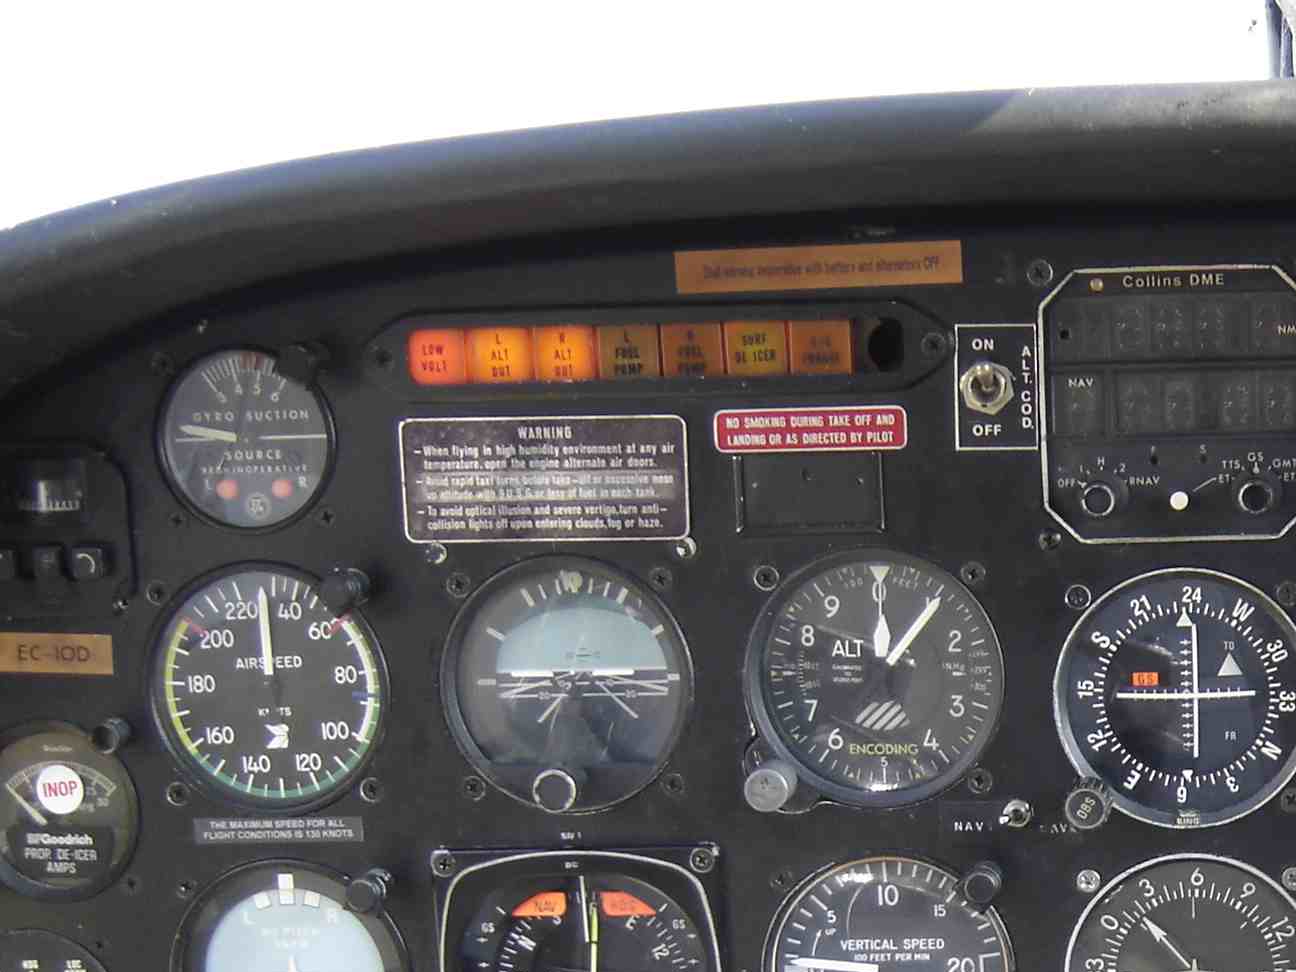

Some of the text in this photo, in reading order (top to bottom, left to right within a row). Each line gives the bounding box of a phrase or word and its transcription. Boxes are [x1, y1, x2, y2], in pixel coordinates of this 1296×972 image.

[1122, 273, 1224, 288] Collins DME
[423, 345, 443, 355] LOW
[972, 338, 994, 350] ON
[422, 360, 447, 371] VOLT
[1068, 378, 1093, 388] NAV
[726, 414, 894, 428] NO SMOKING DURING TAKE OFF AND
[518, 426, 572, 440] WARNING
[972, 424, 1002, 436] OFF
[728, 432, 894, 446] LANDING OR AS DIRECTED BY PILOT
[225, 450, 281, 460] SOURCE
[226, 602, 257, 619] 220
[278, 603, 302, 619] 40
[832, 640, 863, 656] ALT
[335, 667, 357, 683] 80
[188, 676, 215, 692] 180
[206, 726, 234, 744] 160
[322, 722, 349, 739] 100
[849, 744, 918, 754] ENCODING
[243, 756, 270, 773] 140
[296, 753, 321, 770] 120
[43, 781, 77, 797] INOP
[878, 886, 899, 906] 10
[841, 939, 944, 950] VERTICAL SPEED
